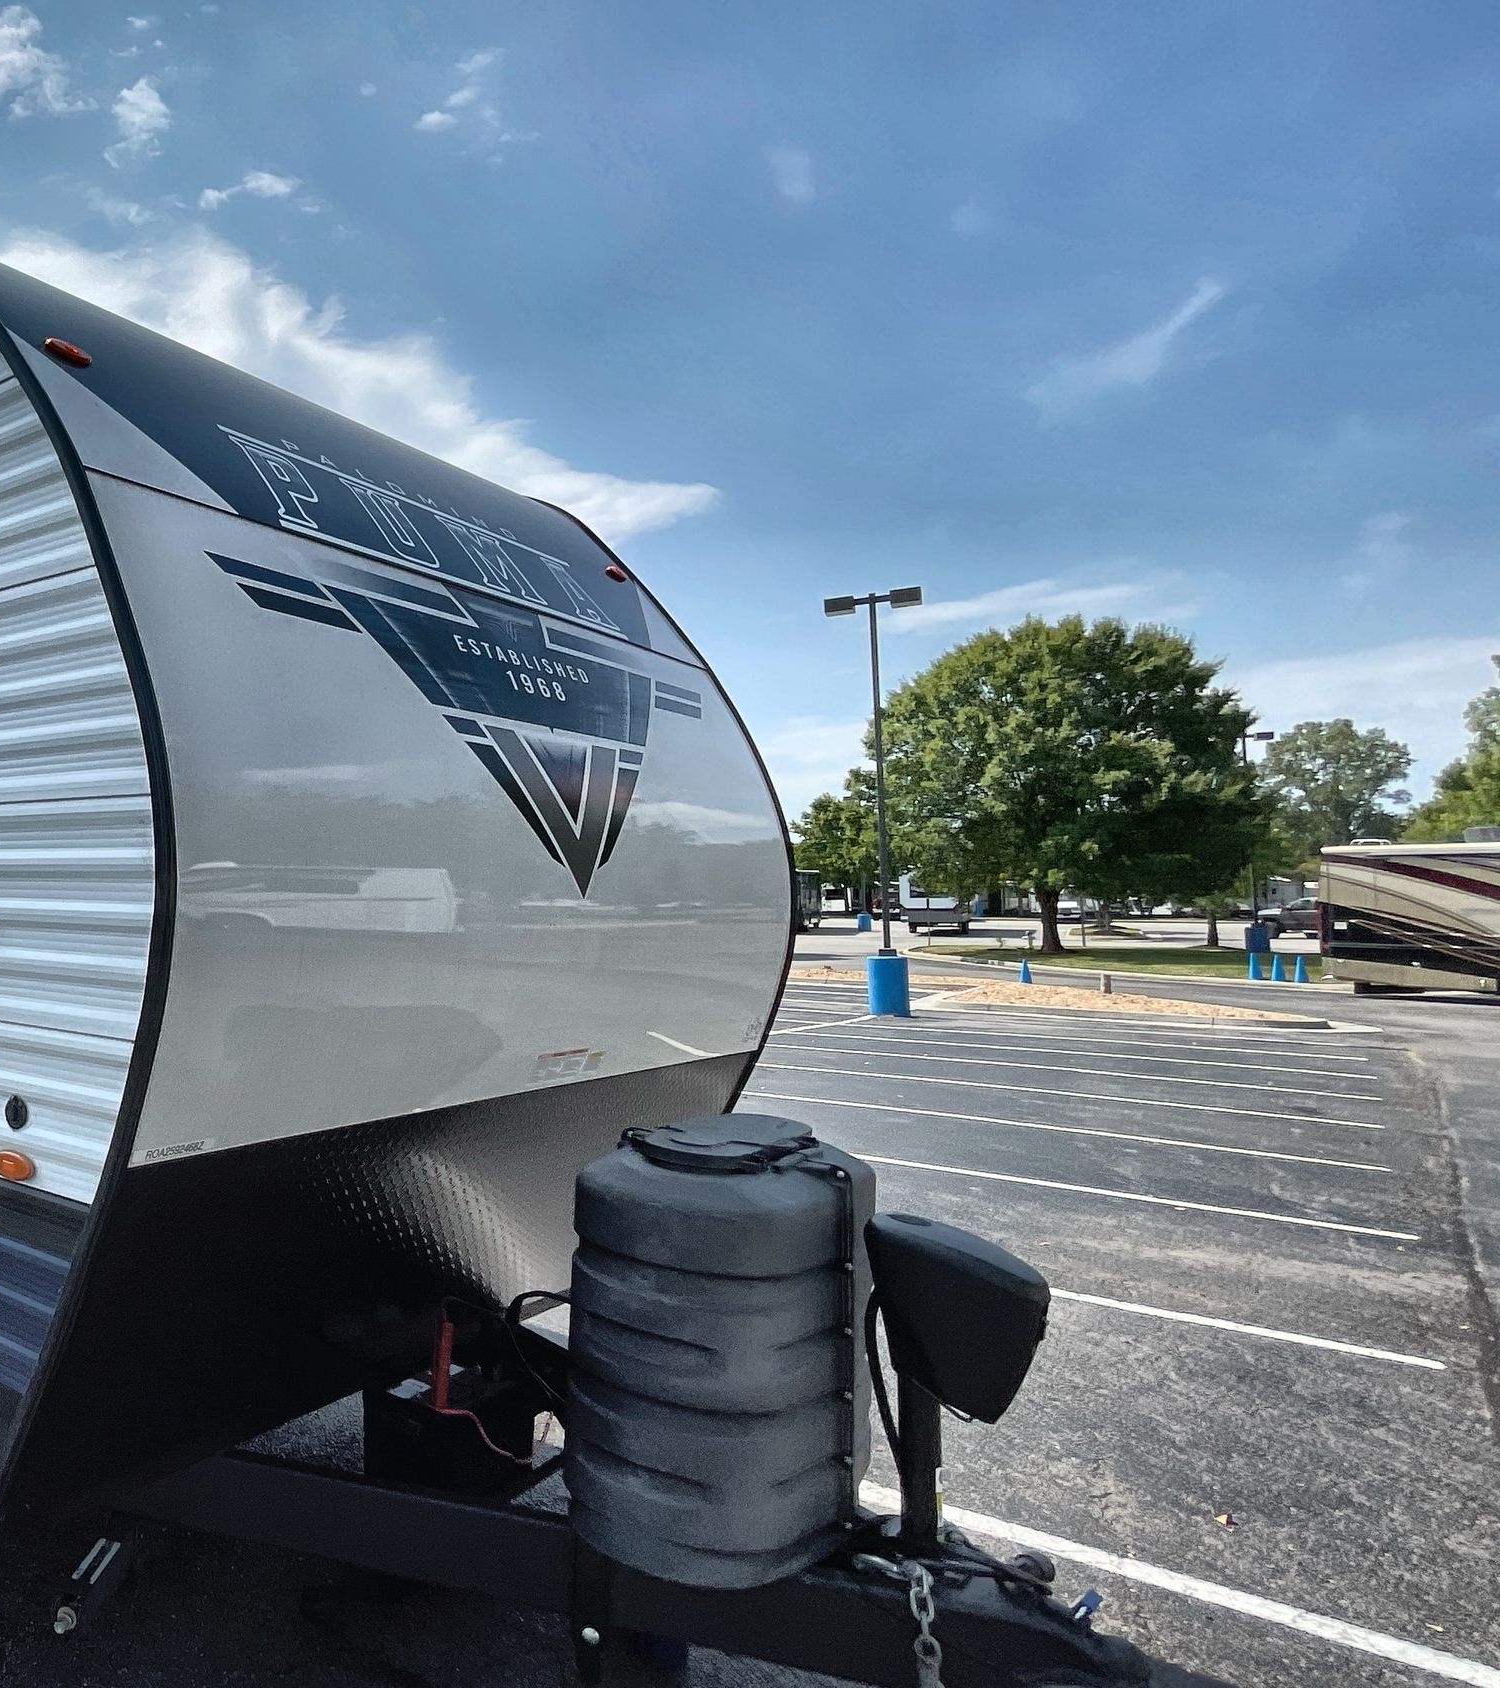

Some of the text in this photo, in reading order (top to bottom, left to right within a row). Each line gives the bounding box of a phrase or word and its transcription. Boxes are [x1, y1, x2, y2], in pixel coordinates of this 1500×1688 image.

[280, 438, 516, 542] PALOMINO
[227, 432, 622, 634] PUMA
[453, 634, 589, 683] ESTABLISHED
[506, 670, 566, 702] 1968
